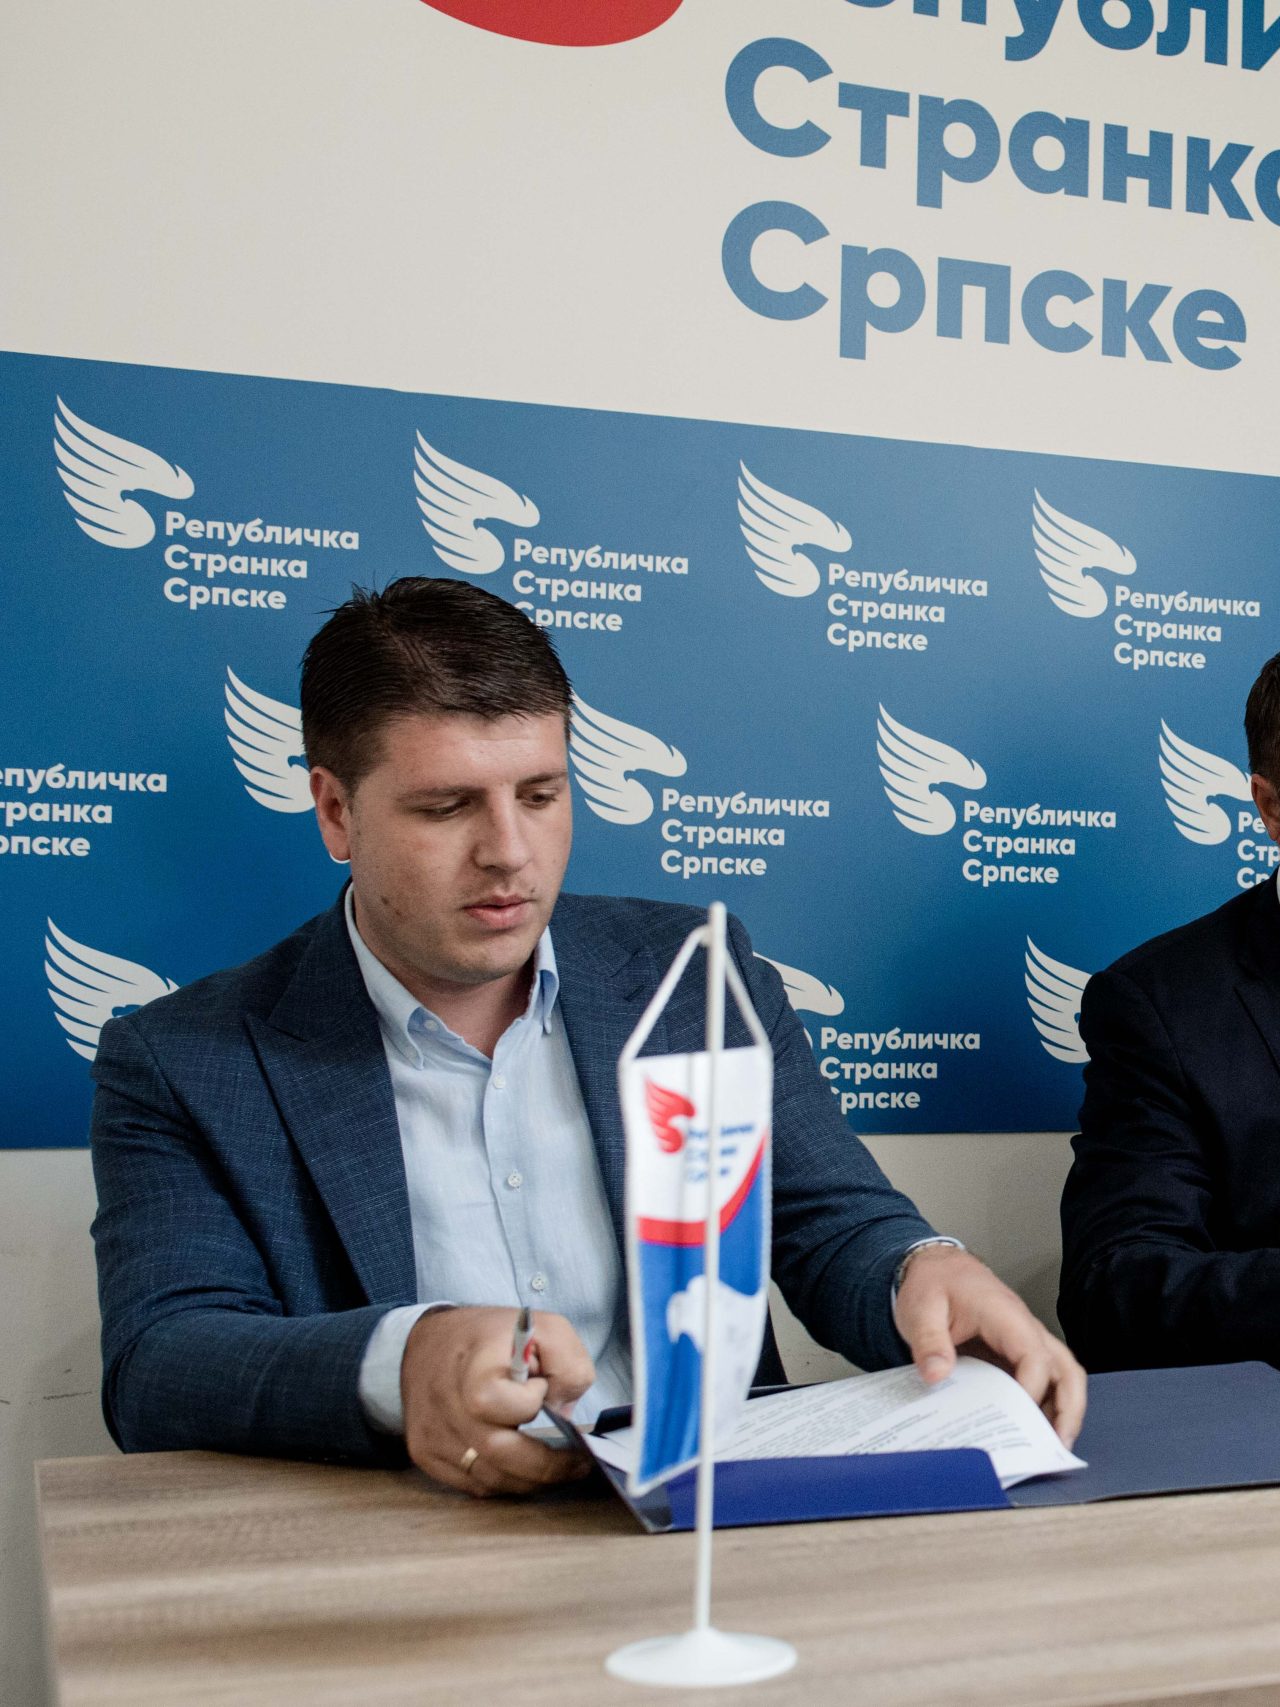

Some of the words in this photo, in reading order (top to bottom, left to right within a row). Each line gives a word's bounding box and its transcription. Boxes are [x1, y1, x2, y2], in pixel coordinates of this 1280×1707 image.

[721, 200, 1247, 371] Српске
[165, 511, 359, 550] Републичка
[164, 544, 308, 579] Странка
[513, 538, 689, 575] Републичка
[163, 576, 287, 610] Српске
[512, 569, 642, 602] Странка
[828, 562, 988, 597] Републичка
[827, 592, 946, 624] Странка
[1114, 584, 1261, 617] Републичка
[826, 622, 929, 653] Српске
[1114, 613, 1222, 643] Странка
[1113, 641, 1207, 671] Српске
[0, 763, 168, 794] публичка
[0, 801, 113, 827] ранка
[662, 788, 830, 820] Републичка
[963, 800, 1116, 830] Републичка
[661, 818, 785, 850] Странка
[962, 829, 1076, 859] Странка
[660, 849, 767, 880] Српске
[962, 858, 1059, 887] Српске
[820, 1026, 981, 1056] Републичка
[820, 1056, 938, 1085] Странка
[831, 1086, 921, 1115] рпске
